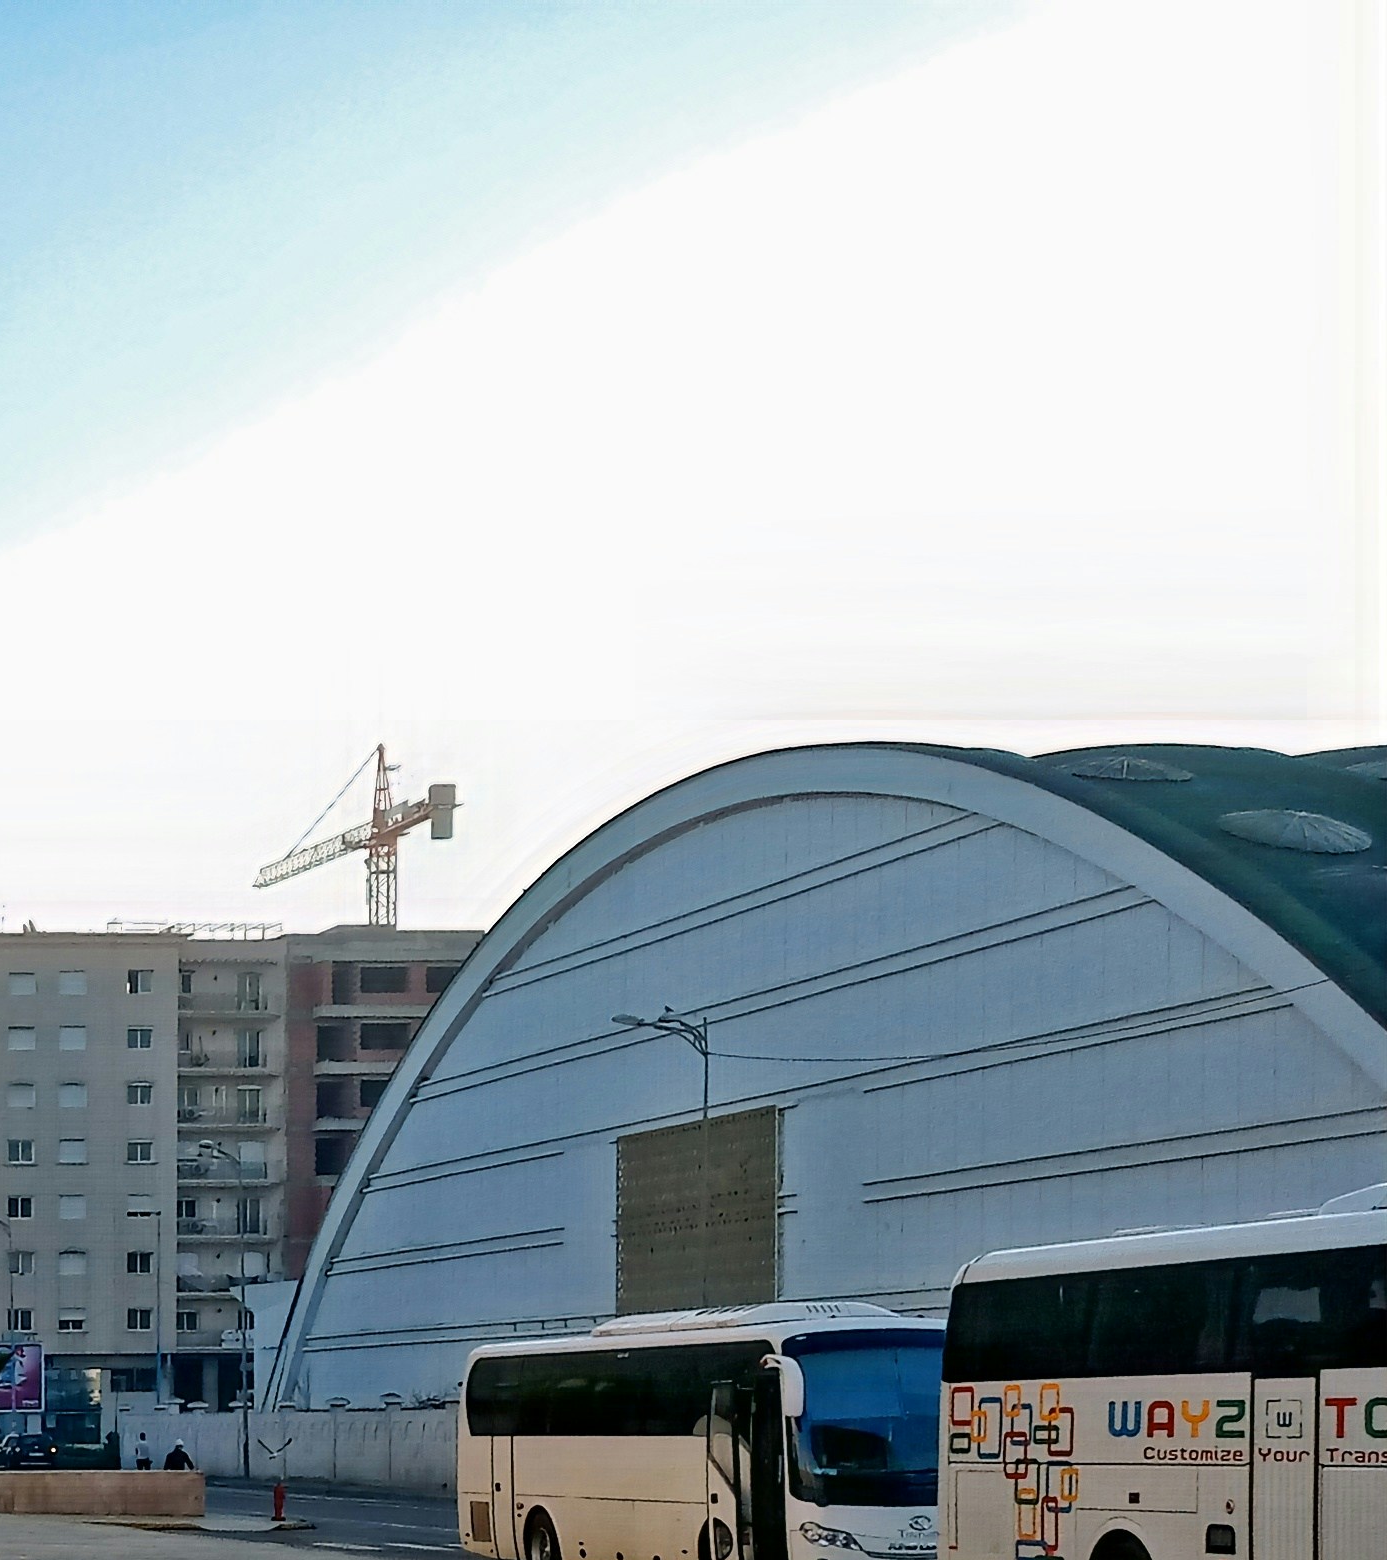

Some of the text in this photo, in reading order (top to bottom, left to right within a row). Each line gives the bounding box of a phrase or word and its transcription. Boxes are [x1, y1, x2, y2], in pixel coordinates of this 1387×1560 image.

[1108, 1399, 1245, 1438] WAY2
[1144, 1446, 1243, 1461] Customize
[1258, 1447, 1310, 1462] Your
